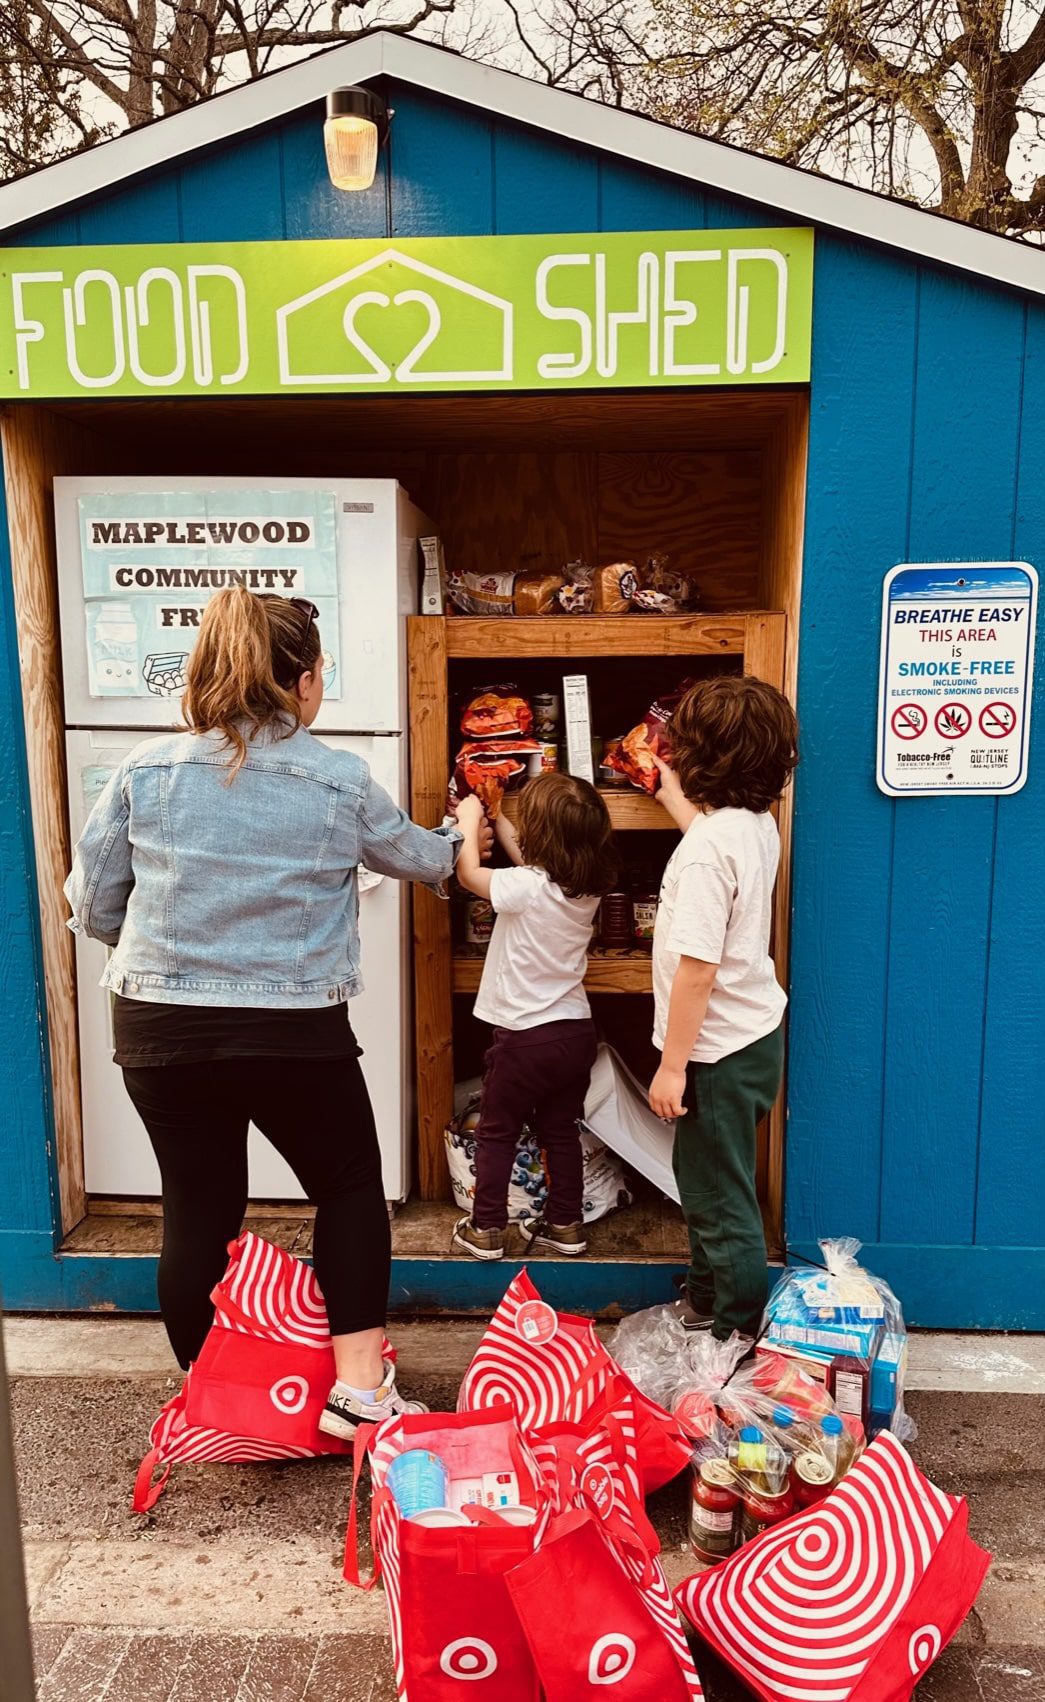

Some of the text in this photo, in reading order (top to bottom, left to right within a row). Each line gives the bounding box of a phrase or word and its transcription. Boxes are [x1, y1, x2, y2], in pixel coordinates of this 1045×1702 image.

[12, 248, 790, 389] FOOD SHED
[92, 522, 311, 544] MAPLEWOOD
[115, 568, 298, 588] COMMUNITY
[894, 608, 1025, 624] BREATHE EASY
[919, 628, 997, 642] THIS AREA
[951, 645, 962, 657] is
[898, 661, 1015, 676] SMOKE-FREE
[933, 678, 978, 687] INCLUDING
[891, 686, 1019, 697] ELECTRONIC SMOKING DEVICES
[896, 752, 952, 762] Tobacco-Free
